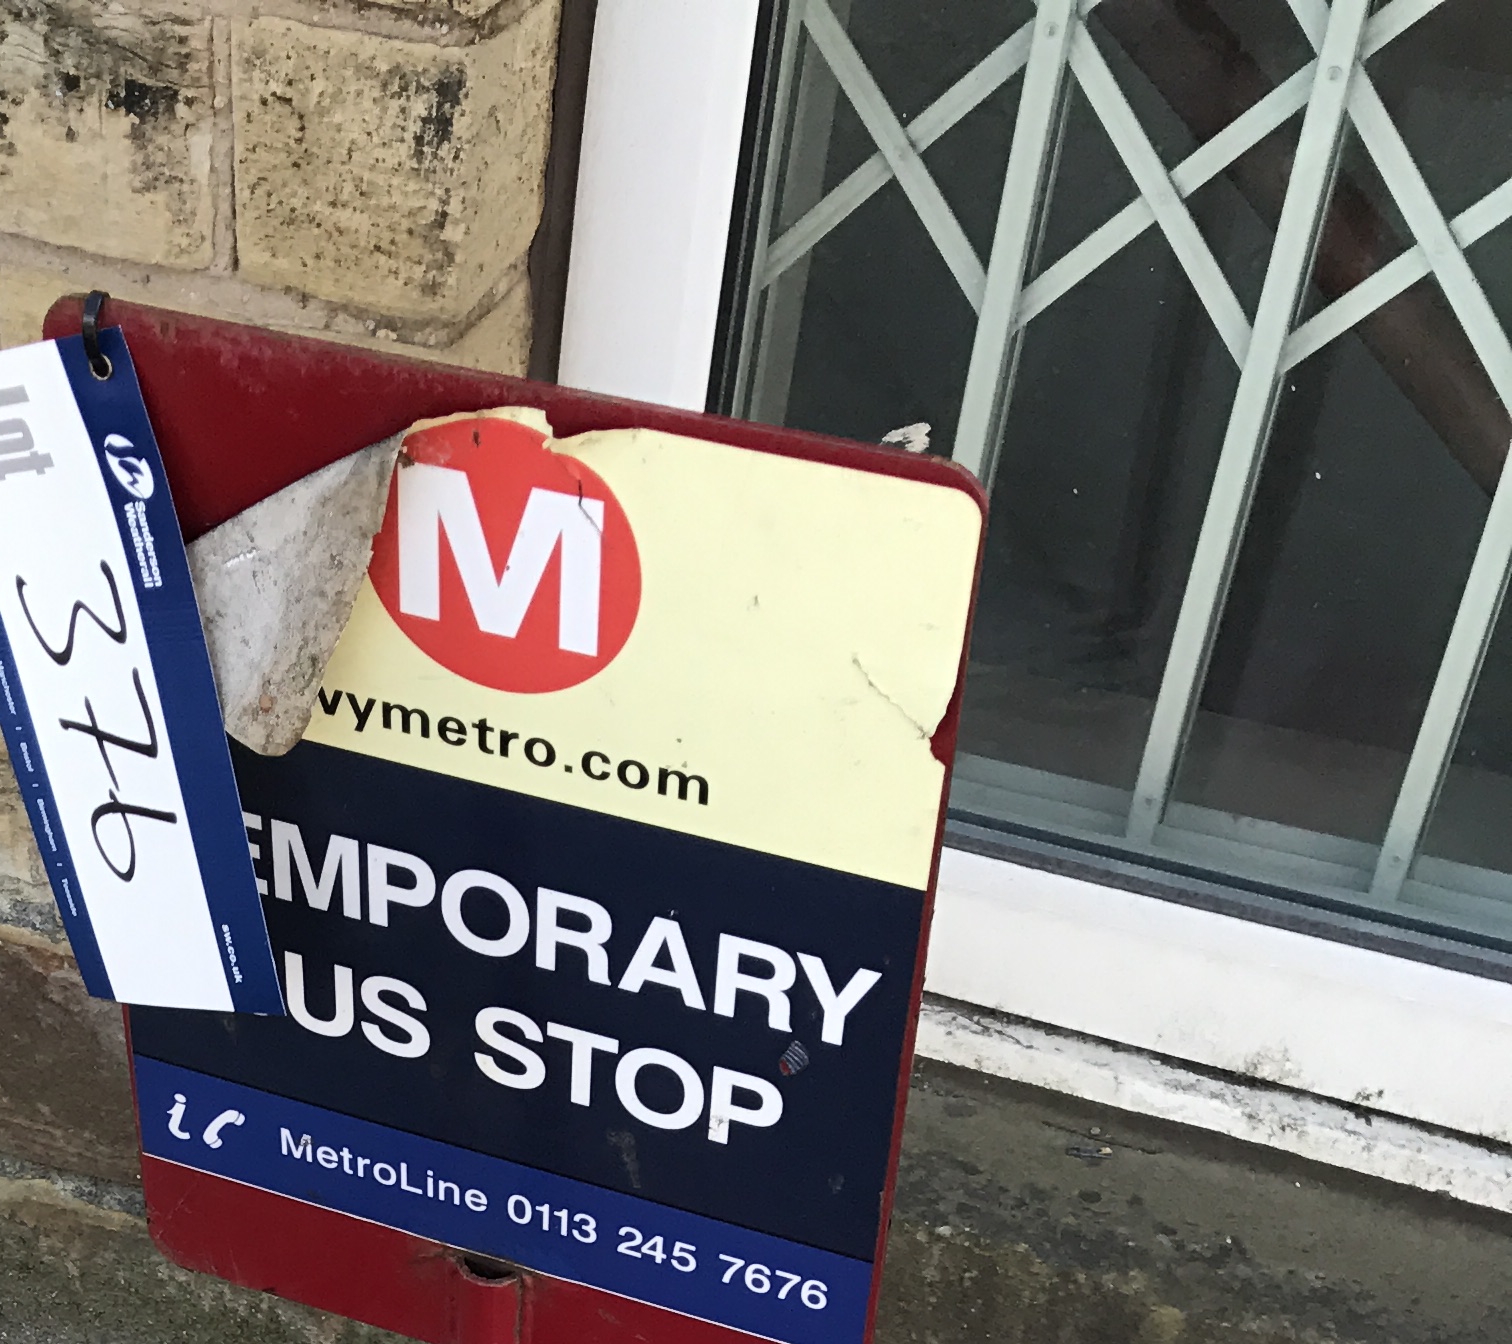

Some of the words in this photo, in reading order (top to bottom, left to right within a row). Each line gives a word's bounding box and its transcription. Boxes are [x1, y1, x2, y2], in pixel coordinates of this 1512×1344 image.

[123, 501, 155, 589] Weatherall
[134, 500, 163, 588] Sanderson
[396, 459, 606, 659] M
[16, 559, 178, 883] 376
[19, 742, 34, 773] Bristol
[37, 798, 58, 853] Birmingham
[61, 877, 78, 917] Teesside
[221, 923, 243, 984] sw.co.uk
[241, 811, 883, 1048] MPORARY
[284, 950, 432, 1060] US
[473, 1004, 784, 1147] STOP
[278, 1126, 489, 1214] MetroLine
[505, 1194, 599, 1246] 0113
[615, 1225, 699, 1274] 245
[717, 1253, 831, 1312] 7676
